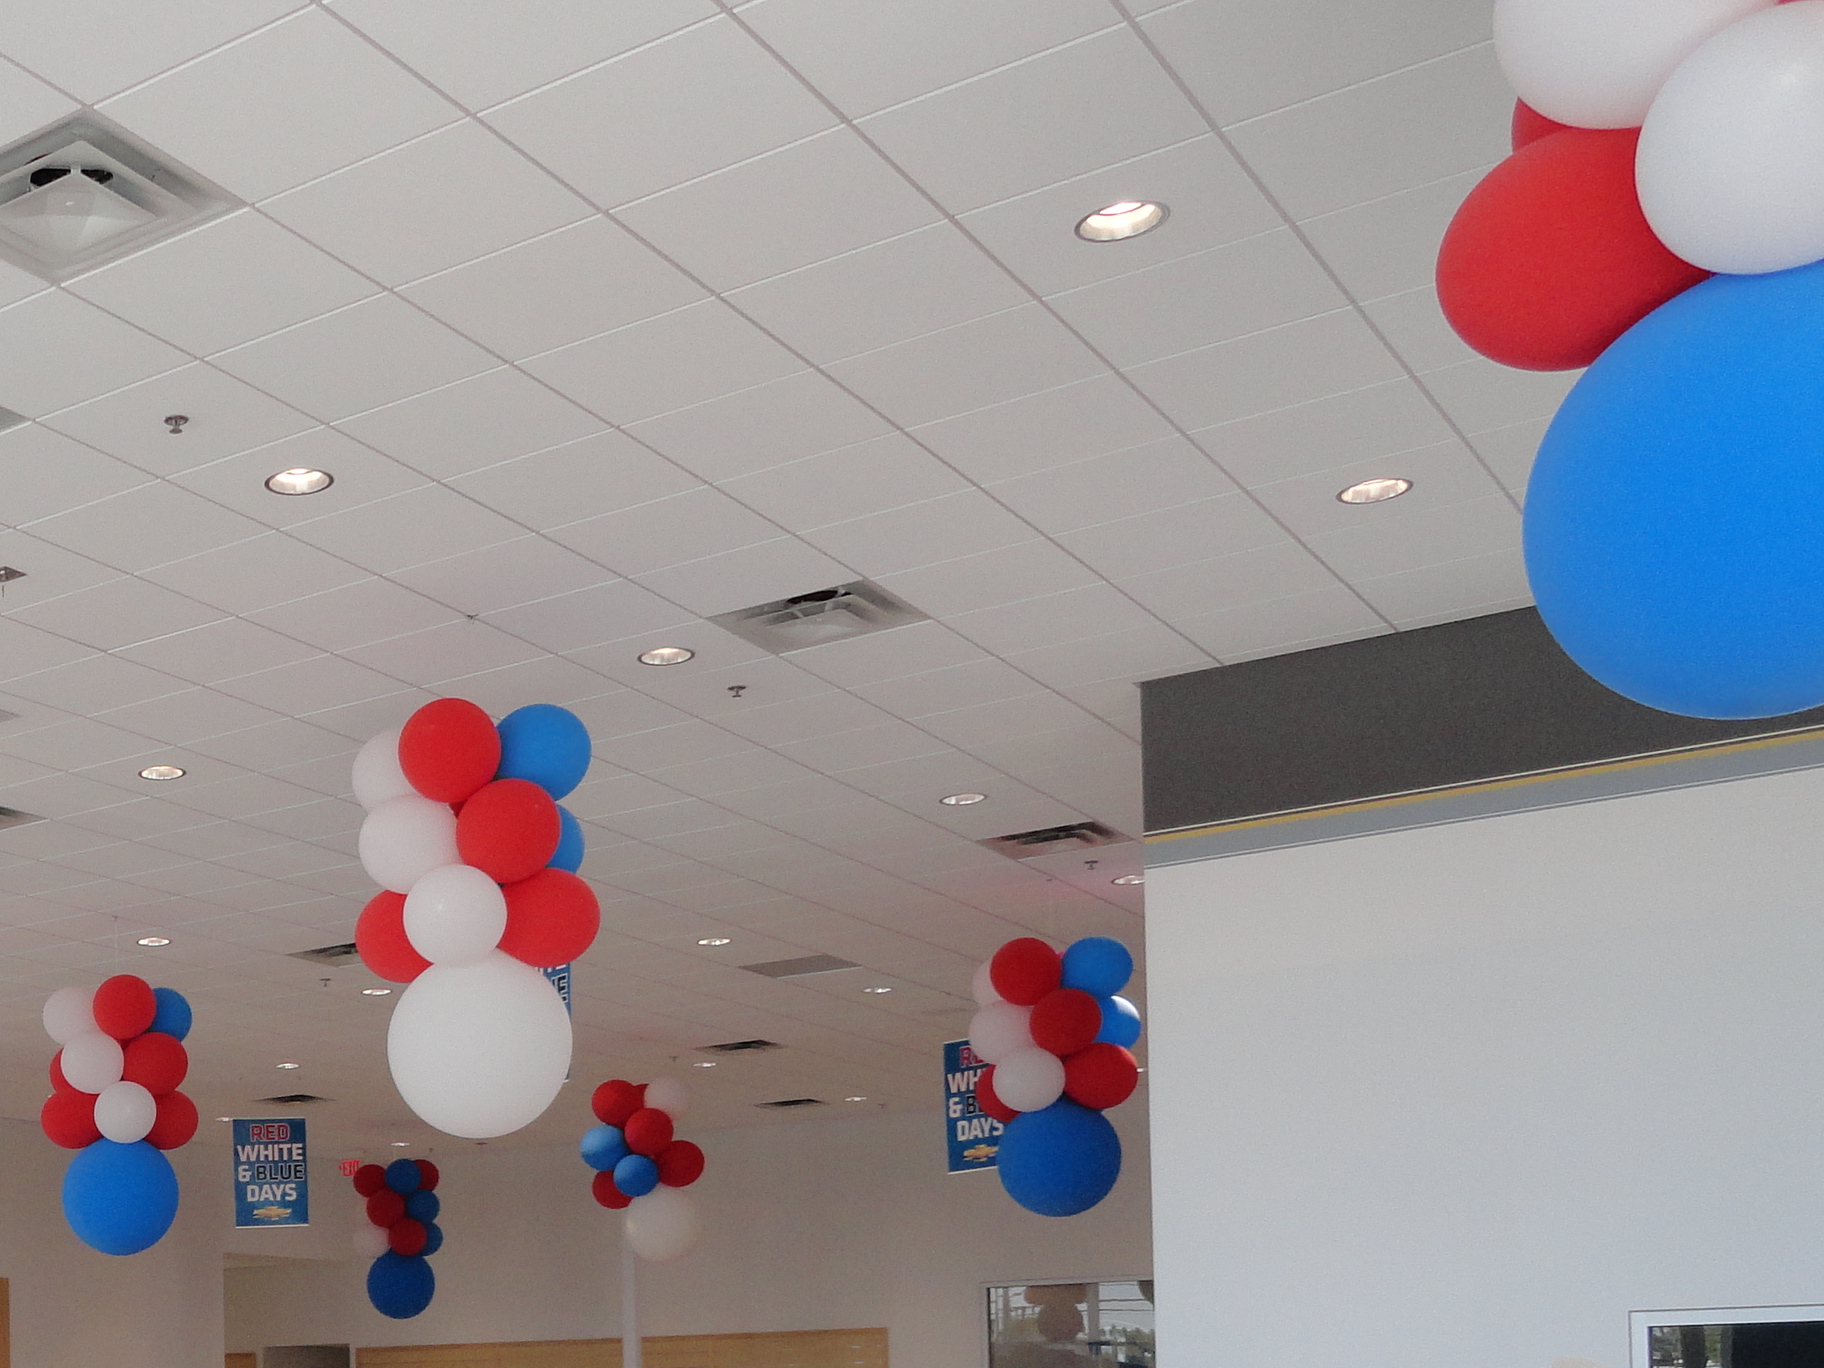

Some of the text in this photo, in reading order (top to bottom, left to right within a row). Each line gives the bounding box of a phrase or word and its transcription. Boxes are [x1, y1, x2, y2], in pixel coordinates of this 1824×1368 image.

[948, 1097, 963, 1118] &
[250, 1123, 290, 1142] RED
[956, 1117, 1004, 1142] DAYS
[236, 1143, 303, 1162] WHITE
[238, 1162, 305, 1183] & BLUE
[246, 1183, 297, 1202] DAYS
